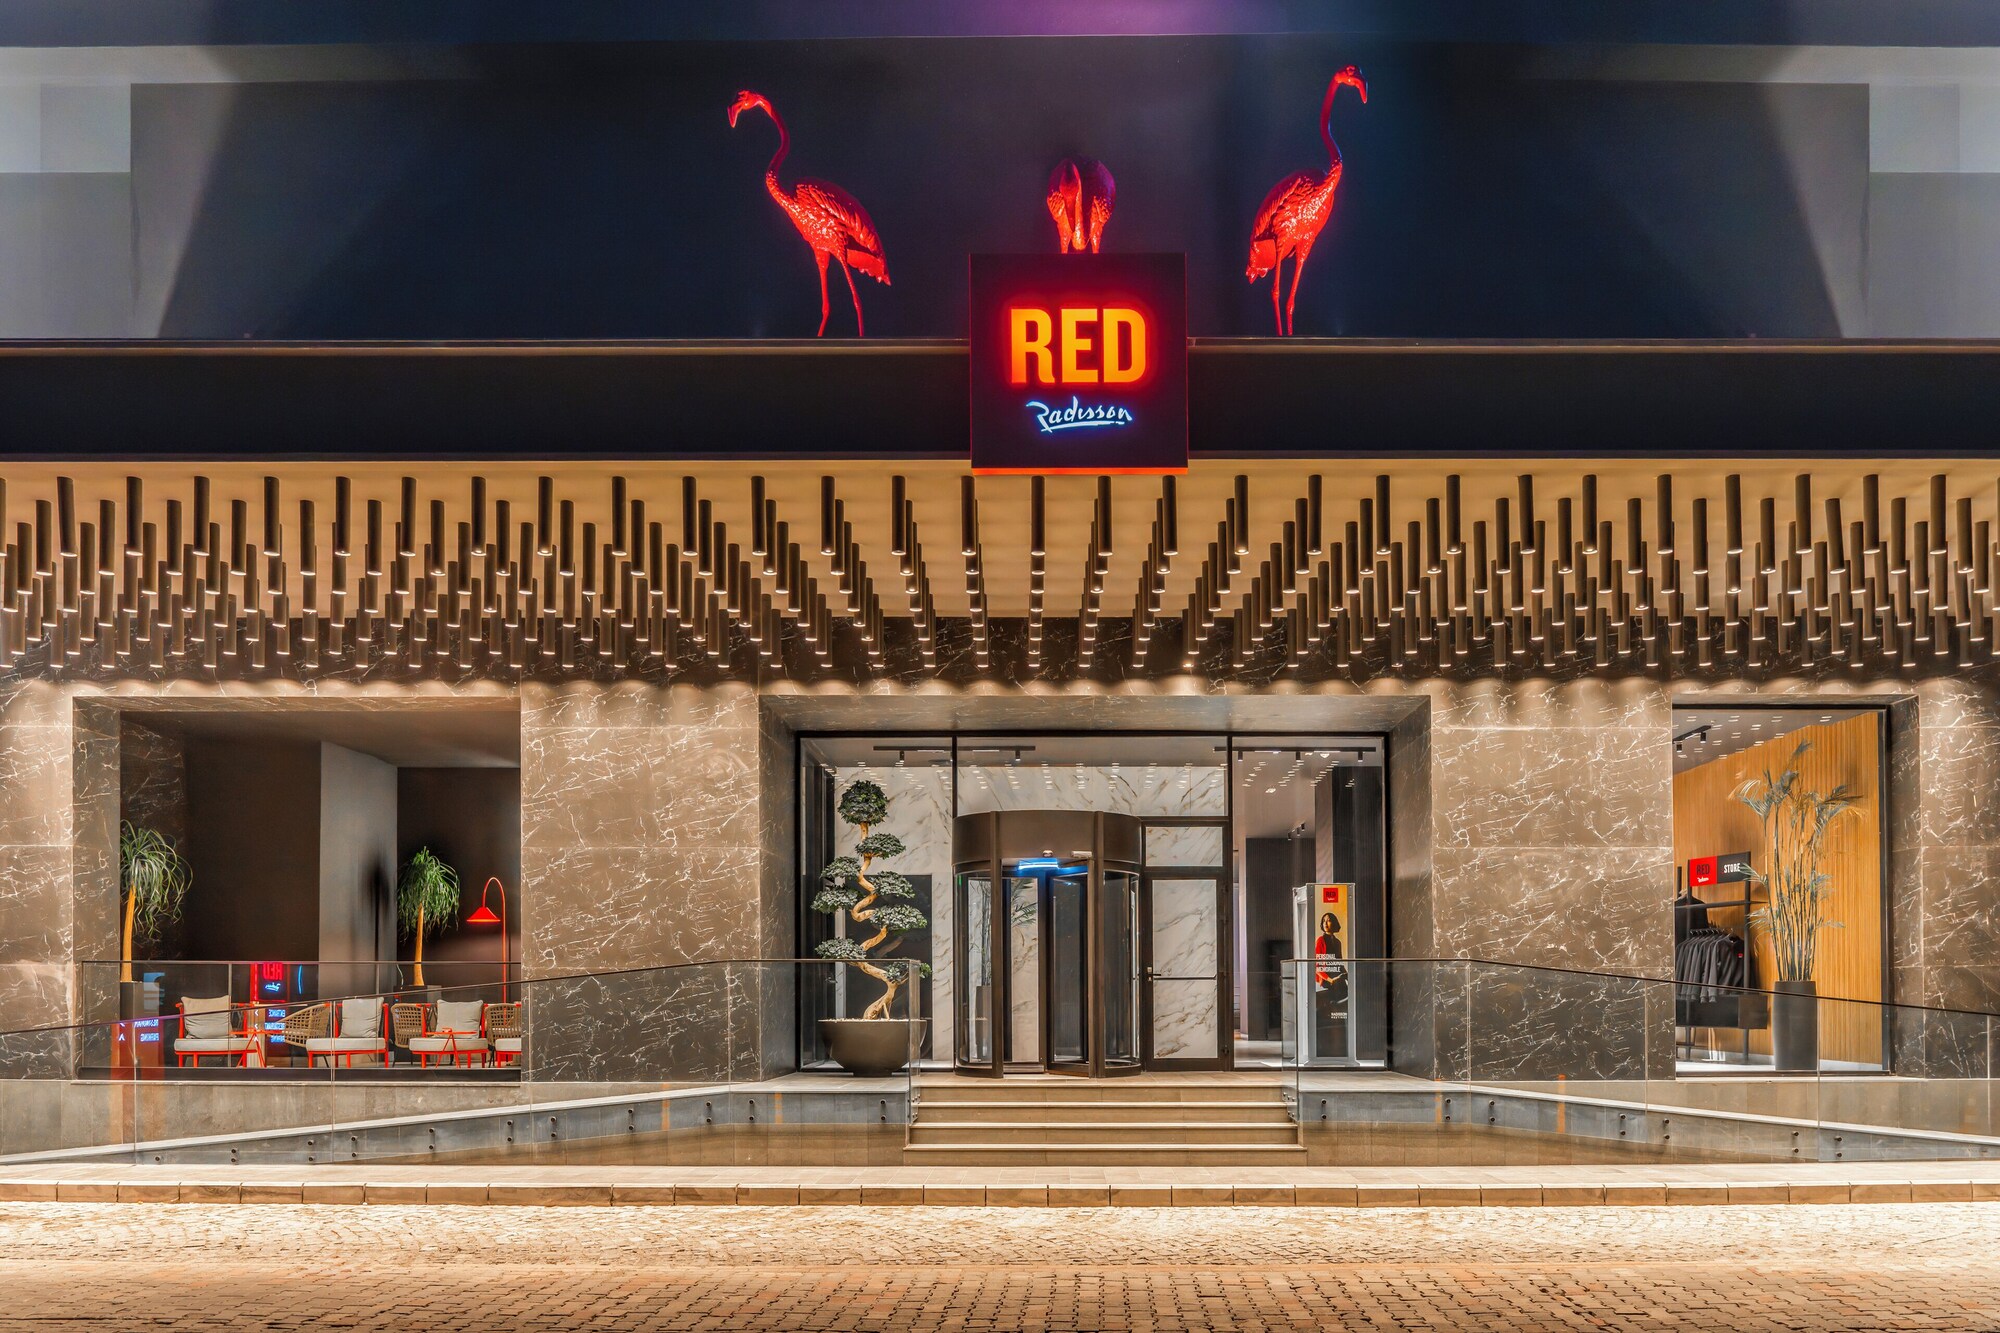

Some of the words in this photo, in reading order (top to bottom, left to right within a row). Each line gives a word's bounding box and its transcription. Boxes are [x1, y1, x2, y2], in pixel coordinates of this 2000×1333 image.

[1011, 308, 1146, 383] RED
[1026, 396, 1133, 432] Radisson
[1696, 863, 1710, 875] RED
[1723, 863, 1741, 874] STORE
